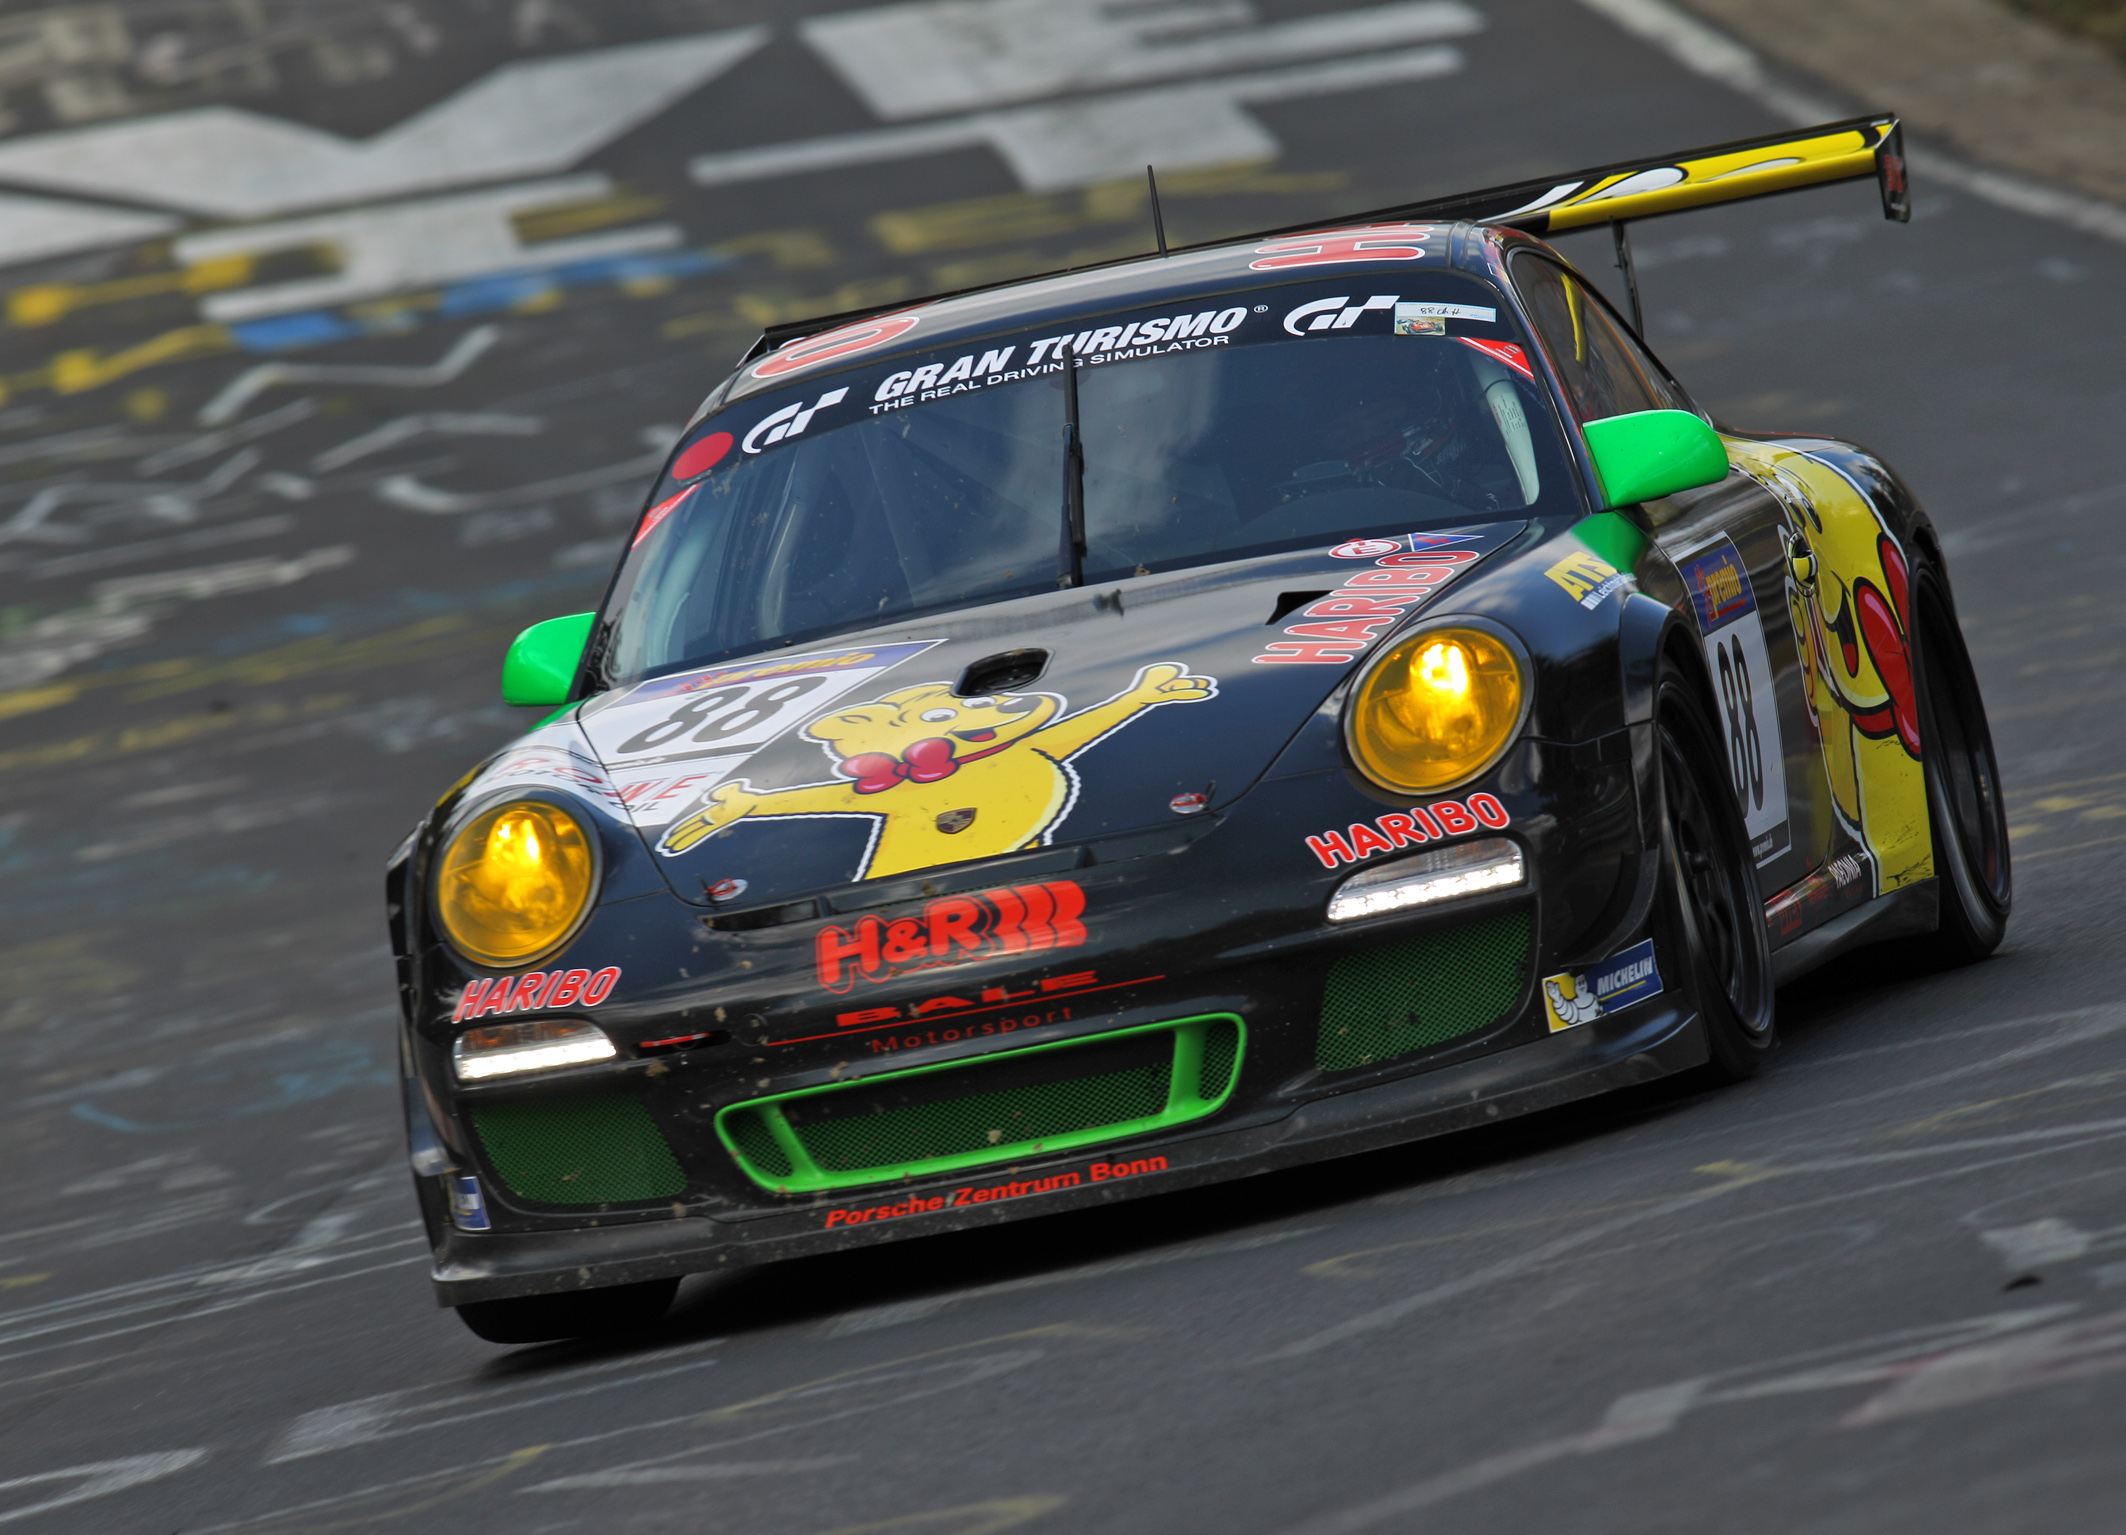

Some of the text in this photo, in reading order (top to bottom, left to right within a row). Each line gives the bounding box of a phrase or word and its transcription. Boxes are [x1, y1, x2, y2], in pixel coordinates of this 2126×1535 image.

[869, 335, 1230, 415] THE REAL DRIVING SIMULATOR
[874, 345, 1016, 402] GRAN
[1028, 306, 1248, 366] TURISMO
[1251, 550, 1480, 664] HARIBO
[1543, 550, 1618, 602] ATS
[616, 676, 828, 754] 88
[1717, 633, 1764, 819] 88
[1305, 792, 1511, 868] HARIBO
[816, 894, 994, 994] H&R
[1596, 956, 1654, 996] MICHELIN
[451, 966, 622, 1024] HARIBO
[835, 970, 1098, 1027] BALE
[871, 1006, 1074, 1053] Motorsport
[824, 1155, 1169, 1228] Porsche Zentrum Bonn
